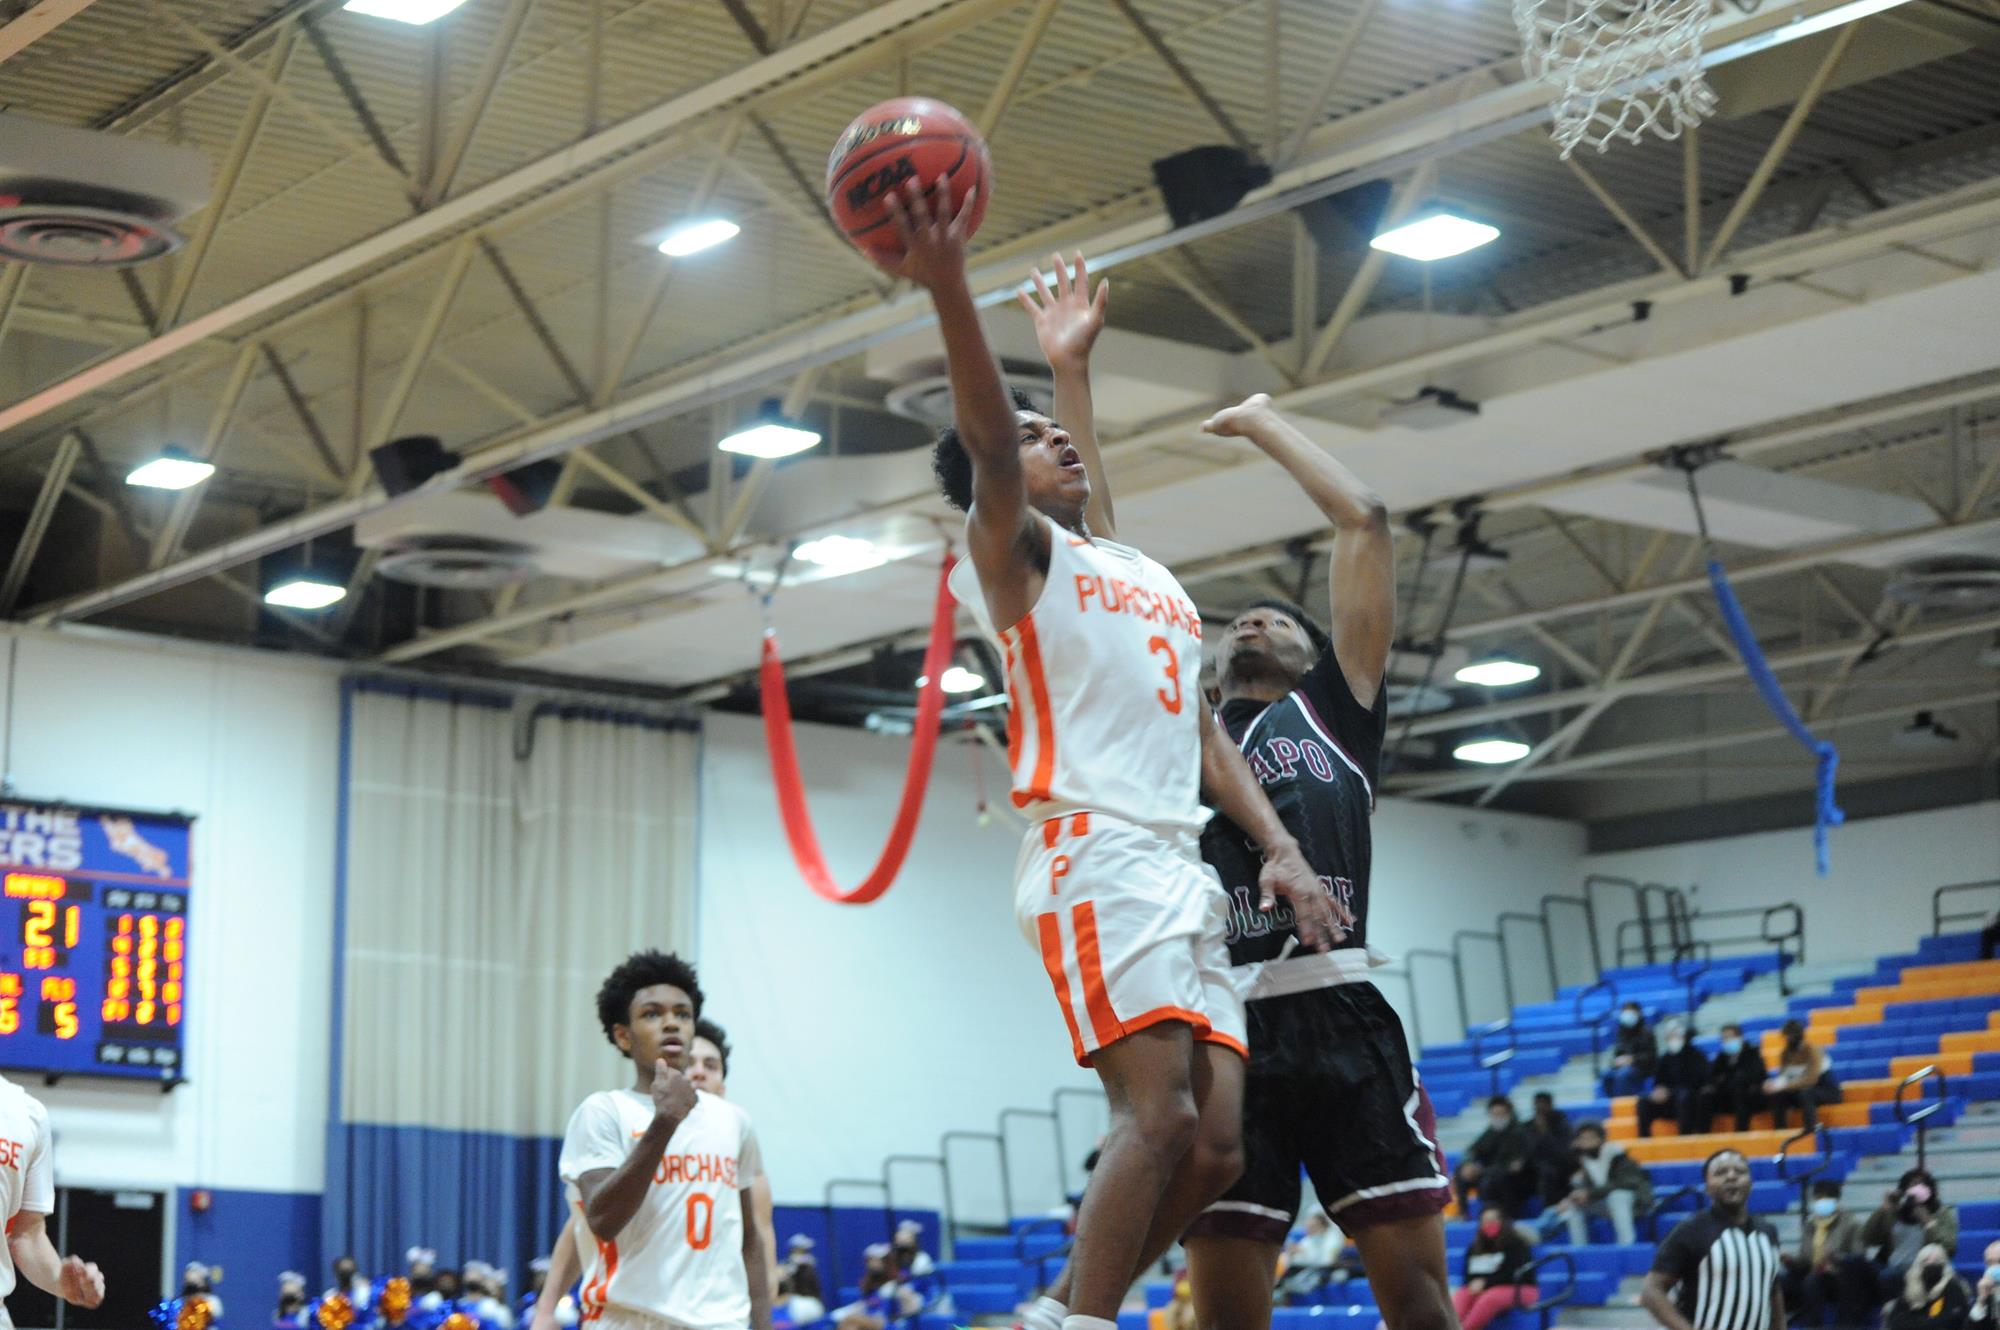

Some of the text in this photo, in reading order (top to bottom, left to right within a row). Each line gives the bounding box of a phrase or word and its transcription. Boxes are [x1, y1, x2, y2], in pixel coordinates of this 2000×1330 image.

[1147, 635, 1182, 716] 3
[1050, 855, 1071, 895] P
[25, 900, 80, 948] 21
[54, 1002, 79, 1039] 5
[686, 1192, 713, 1250] 0
